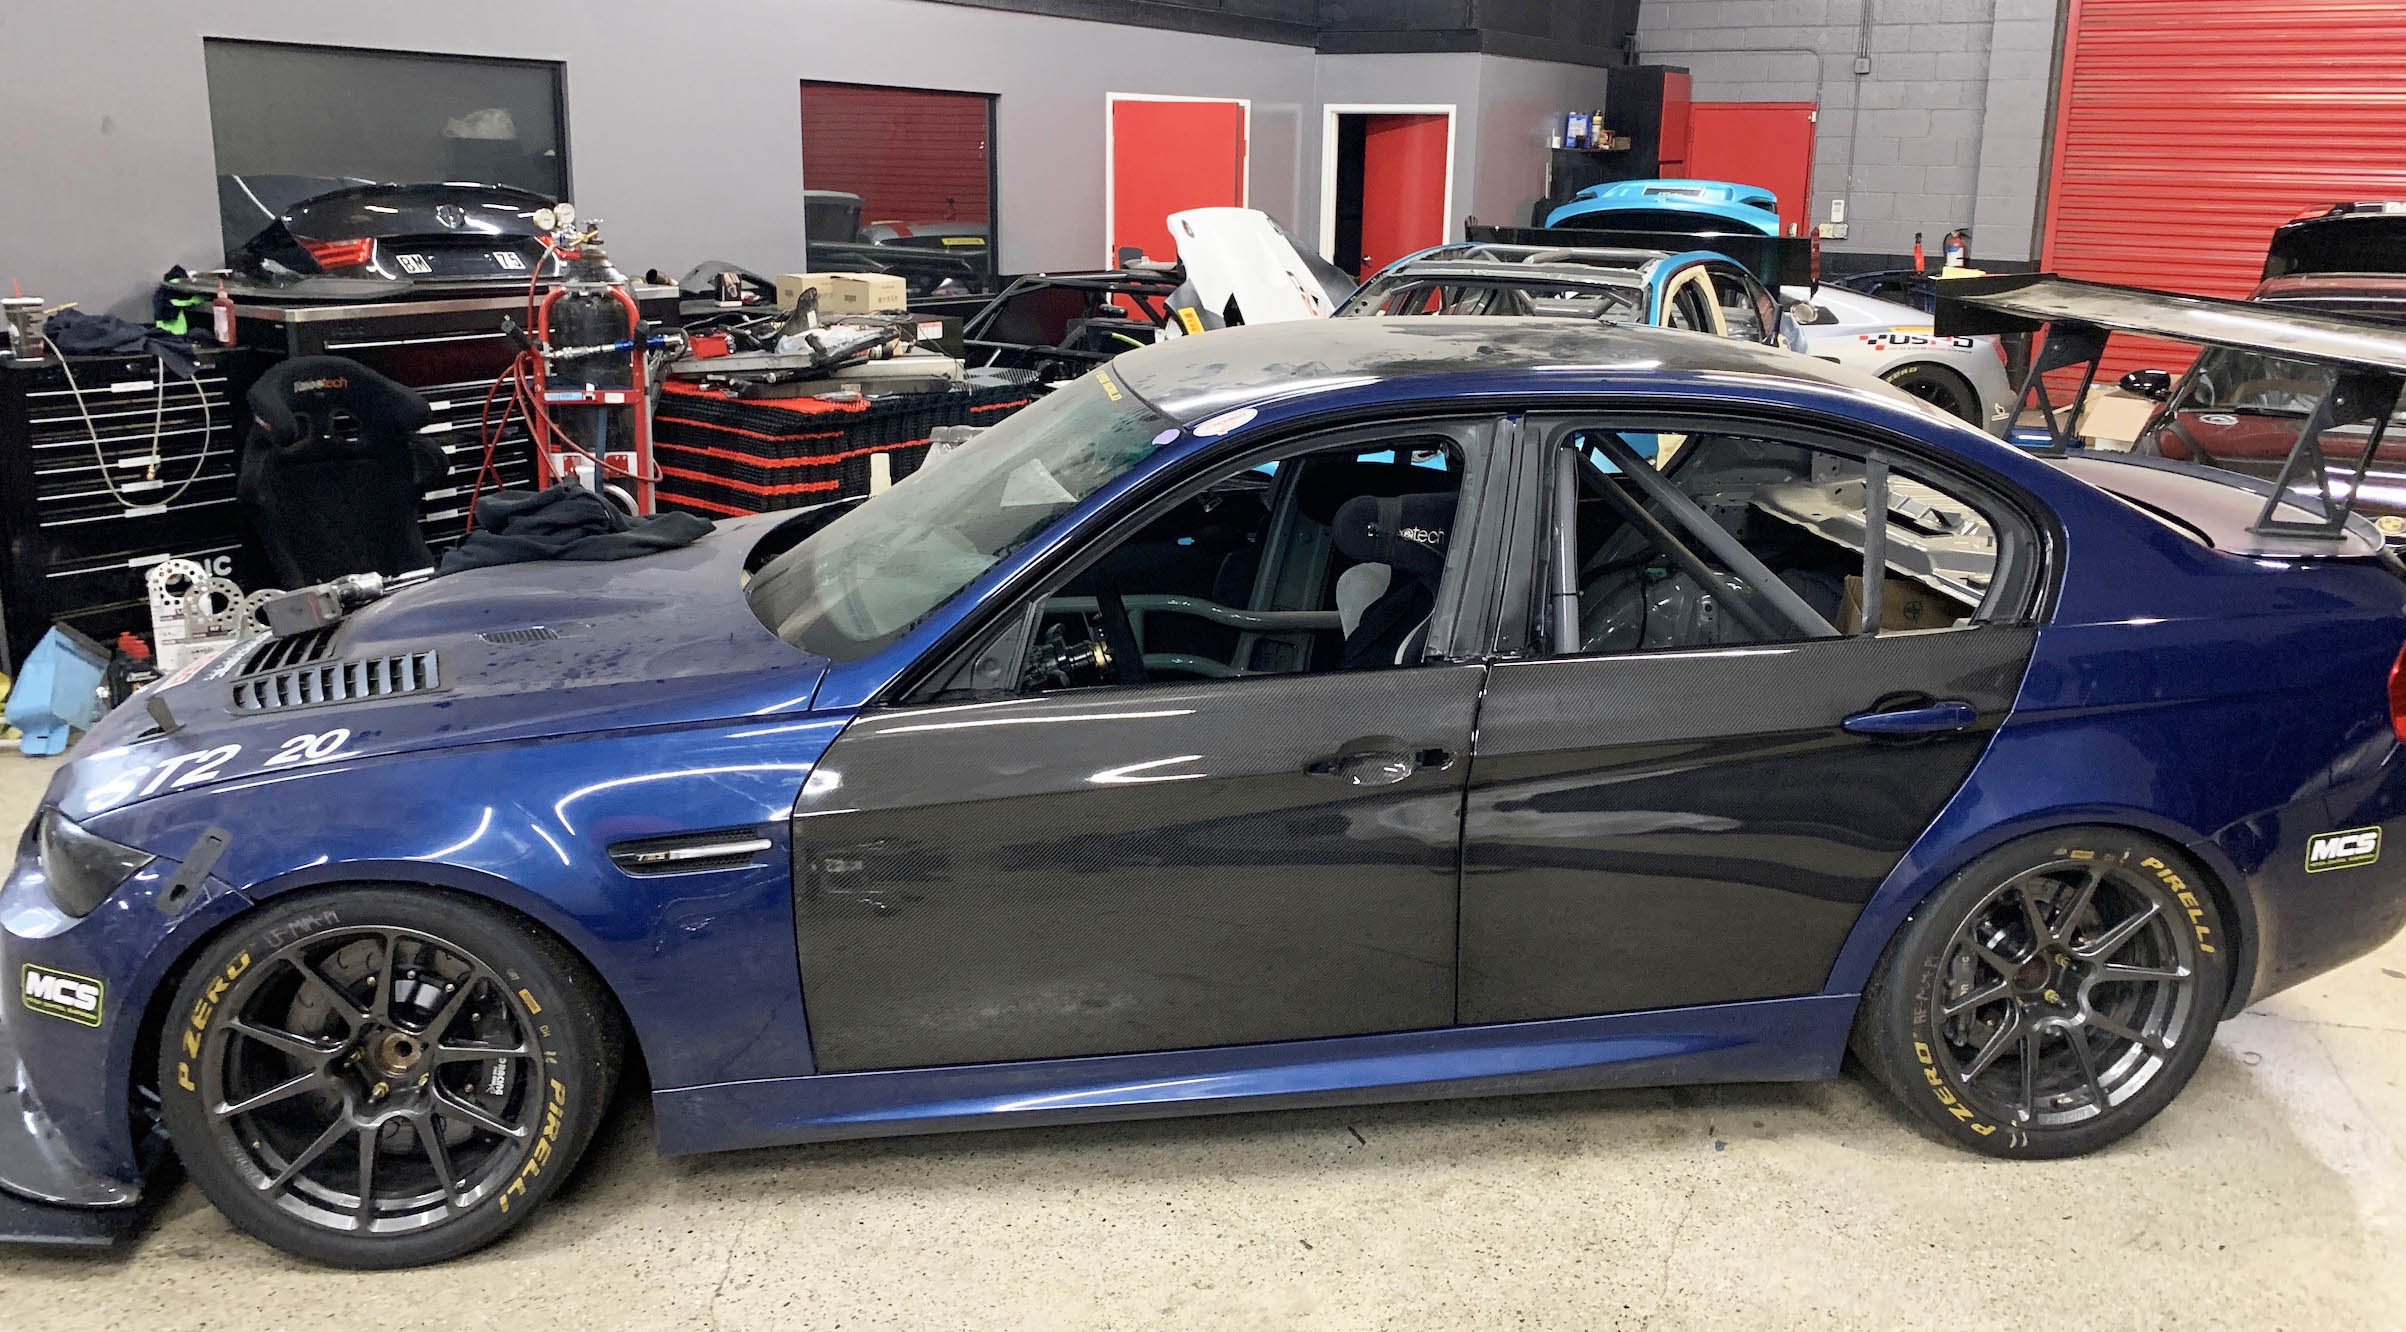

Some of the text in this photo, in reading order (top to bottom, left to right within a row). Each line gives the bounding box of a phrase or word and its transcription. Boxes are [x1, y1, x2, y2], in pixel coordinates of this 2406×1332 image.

[85, 728, 351, 813] ST2 20
[2310, 831, 2378, 862] MCS
[2140, 856, 2215, 953] PIRELLI
[26, 970, 99, 1012] MCS
[499, 1077, 567, 1214] PIRELLI
